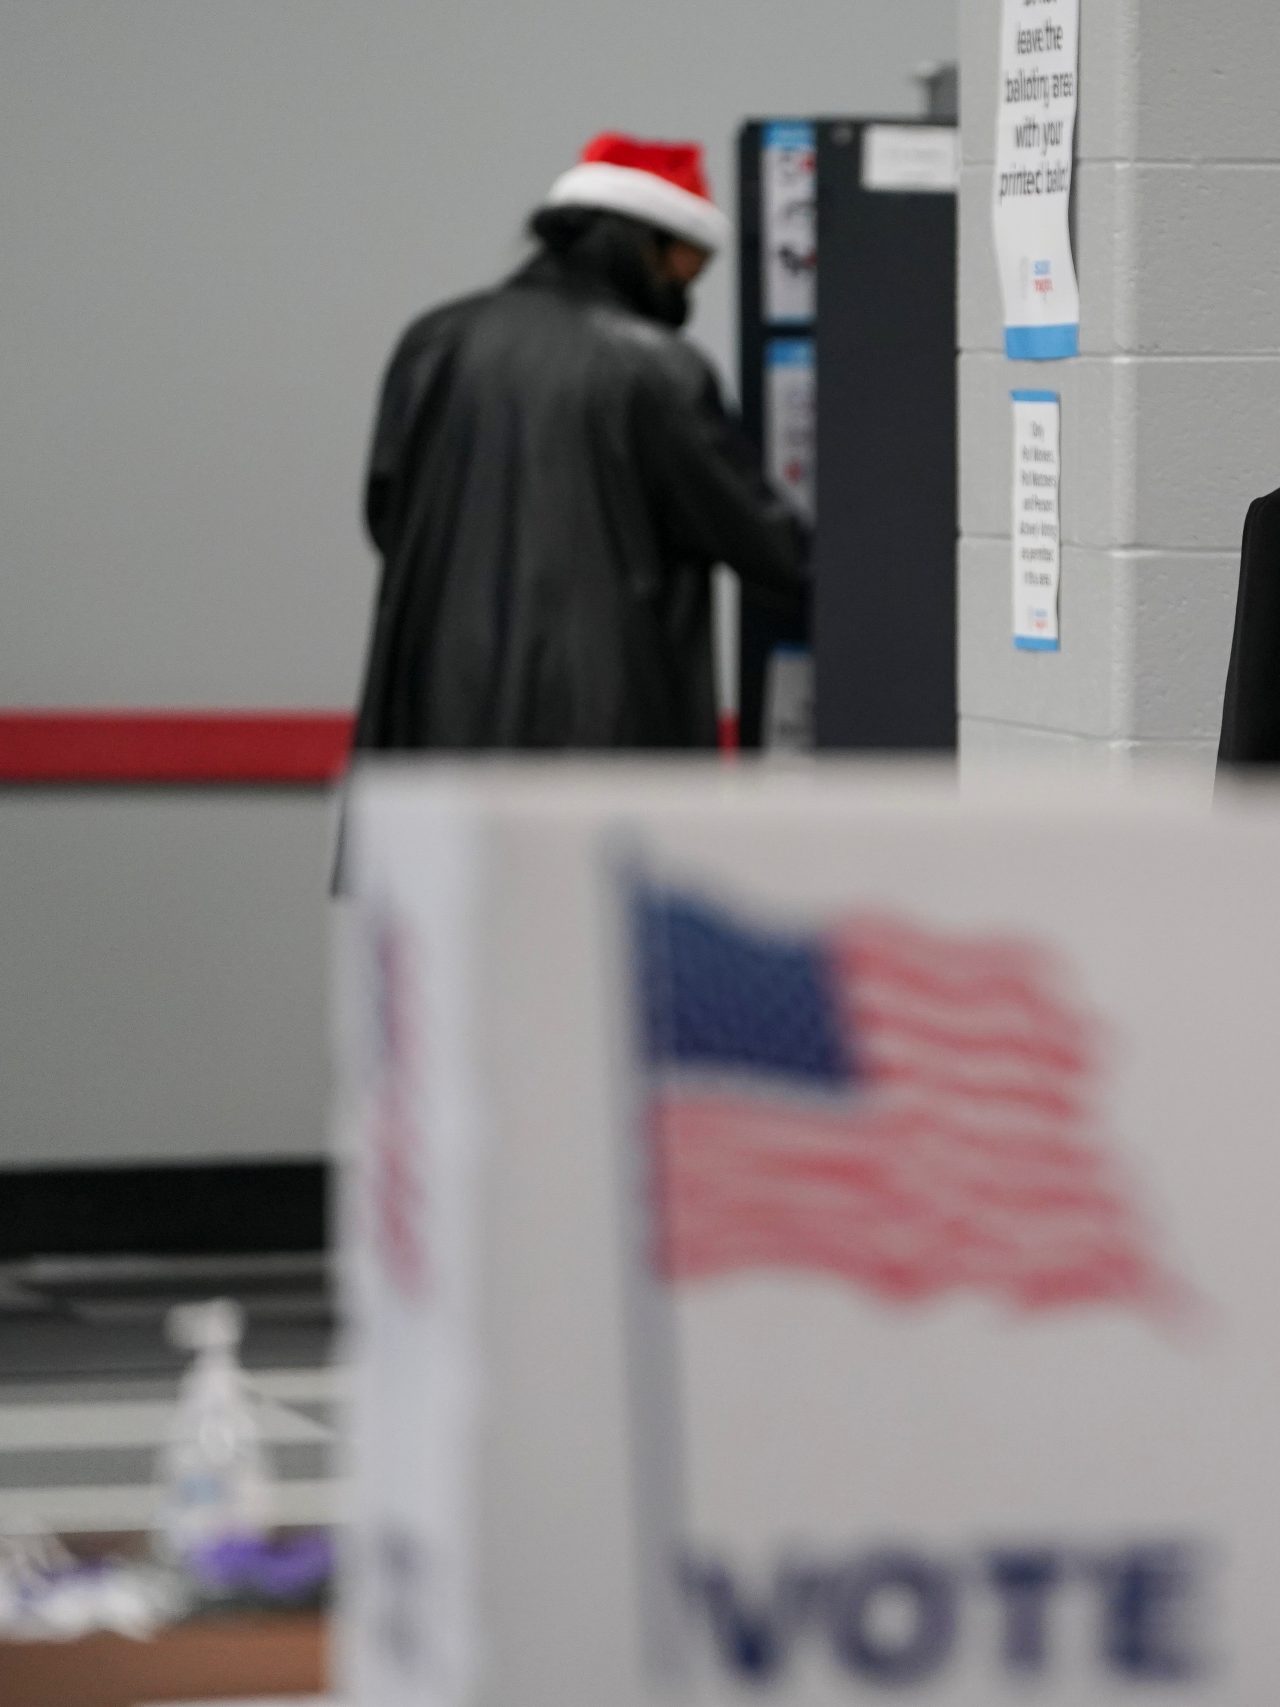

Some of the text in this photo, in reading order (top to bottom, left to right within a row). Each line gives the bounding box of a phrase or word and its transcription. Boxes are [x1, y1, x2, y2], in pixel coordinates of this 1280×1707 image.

[1017, 17, 1064, 54] leave the
[1006, 66, 1073, 108] balloting area
[1015, 115, 1064, 156] with your
[999, 161, 1043, 208] printed
[682, 1540, 1212, 1687] VOTE
